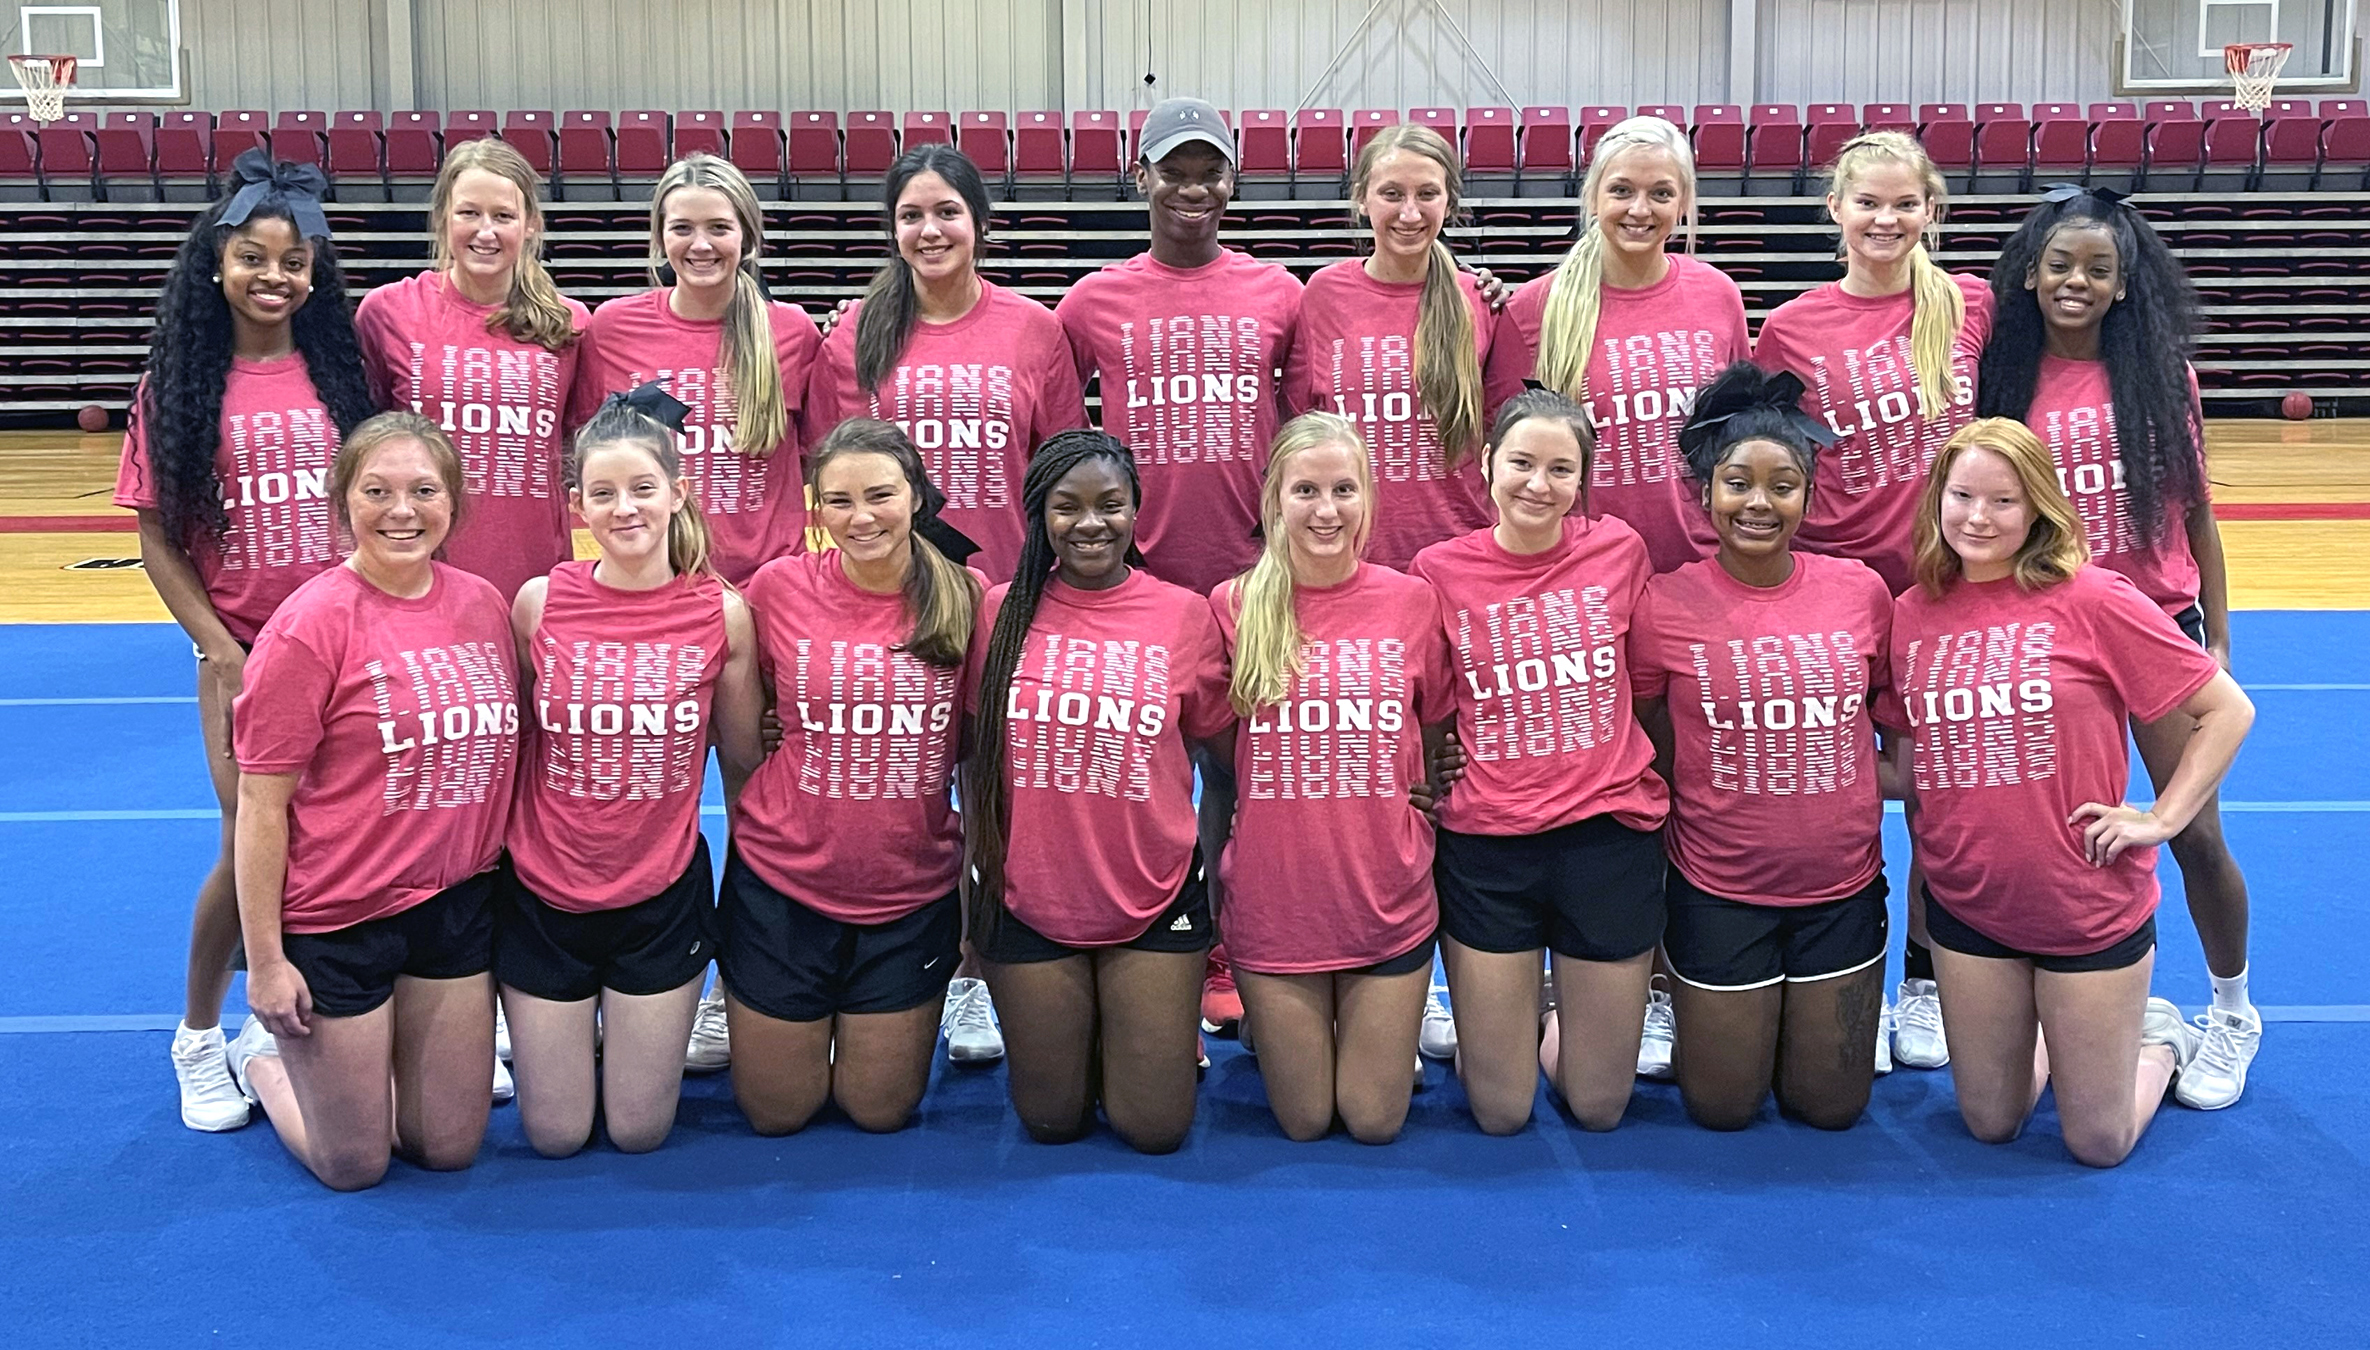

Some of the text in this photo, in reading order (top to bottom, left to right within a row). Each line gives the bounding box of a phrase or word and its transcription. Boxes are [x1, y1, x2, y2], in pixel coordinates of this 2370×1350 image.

[1127, 373, 1259, 408] LIONS
[1333, 392, 1431, 422] LIO
[1582, 386, 1697, 429] LION
[1465, 645, 1616, 700] LIONS
[539, 699, 700, 736] LIONS
[796, 701, 952, 735] LIONS
[1007, 686, 1166, 737] LIONS
[1249, 699, 1403, 733] LIONS
[1701, 693, 1863, 730] LIONS
[1904, 679, 2053, 727] LIONS
[377, 702, 519, 753] LIONS
